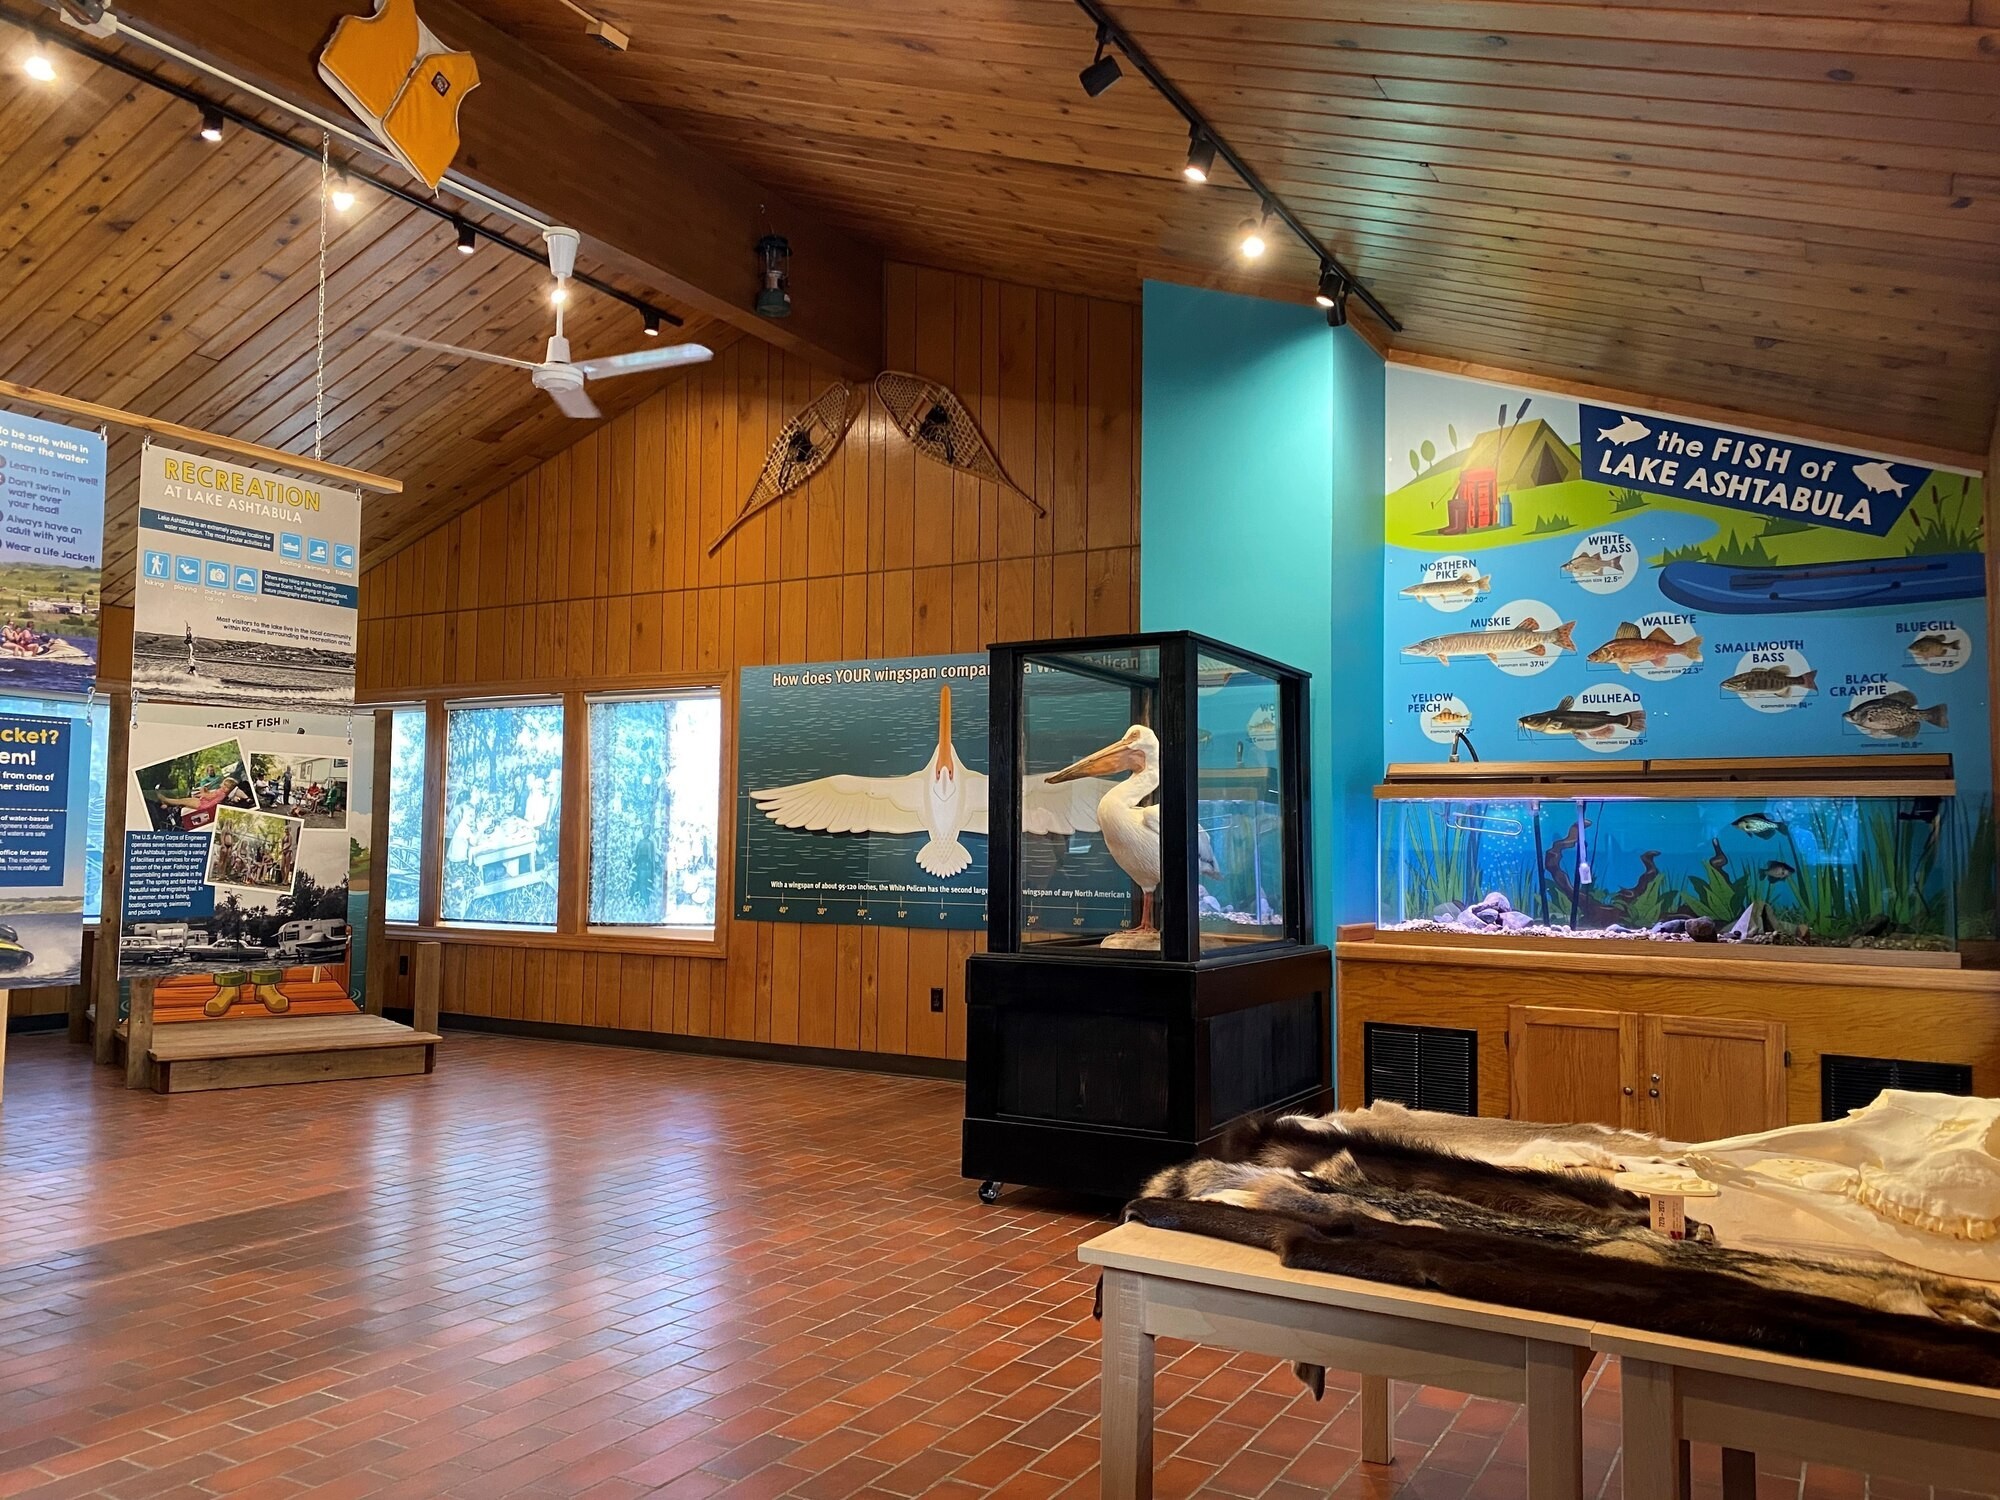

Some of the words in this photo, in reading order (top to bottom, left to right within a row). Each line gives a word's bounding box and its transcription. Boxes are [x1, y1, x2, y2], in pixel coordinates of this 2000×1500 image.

[12, 429, 25, 439] be
[28, 434, 49, 444] safe
[52, 440, 77, 450] while
[80, 445, 88, 454] in
[12, 443, 35, 452] near
[38, 446, 54, 457] the
[1658, 431, 1704, 457] the
[1712, 438, 1792, 474] FISH
[1800, 461, 1837, 482] of
[10, 461, 36, 472] Learn
[40, 467, 49, 476] to
[52, 470, 75, 481] swim
[9, 477, 33, 487] Don't
[36, 483, 60, 494] swim
[63, 487, 70, 496] in
[165, 458, 320, 511] RECREATION
[1599, 450, 1679, 486] LAKE
[1684, 468, 1872, 525] ASHTABULA
[9, 489, 37, 499] water
[40, 495, 62, 504] over
[8, 500, 29, 509] your
[33, 503, 59, 514] head!
[164, 484, 181, 498] AT
[187, 489, 222, 506] LAKE
[228, 499, 302, 523] ASHTABULA
[7, 514, 42, 528] Always
[45, 522, 68, 532] have
[171, 517, 194, 526] Ashtabula
[207, 525, 229, 533] extremely
[230, 529, 246, 537] popular
[6, 525, 30, 536] adult
[33, 530, 53, 540] with
[57, 534, 75, 544] you!
[1589, 534, 1624, 545] WHITE
[6, 541, 31, 552] Wear
[43, 547, 59, 557] Life
[61, 551, 94, 563] Jacket!
[1602, 544, 1631, 554] BASS
[1420, 560, 1476, 572] NORTHERN
[1436, 570, 1458, 579] PIKE
[145, 579, 164, 588] hiking
[174, 584, 197, 593] playing
[1470, 617, 1510, 628] MUSKIE
[1642, 614, 1696, 626] WALLEYE
[1896, 620, 1956, 633] BLUEGILL
[267, 630, 299, 640] surrounding
[310, 636, 337, 644] recreation
[323, 632, 352, 640] community
[1715, 640, 1804, 653] SMALLMOUTH
[1752, 653, 1784, 663] BASS
[773, 673, 799, 687] How
[802, 671, 832, 685] does
[835, 668, 871, 684] YOUR
[874, 667, 937, 684] wingspan
[1846, 673, 1888, 684] BLACK
[1830, 686, 1887, 696] CRAPPIE
[1412, 693, 1453, 703] YELLOW
[1583, 693, 1641, 704] BULLHEAD
[1408, 703, 1441, 712] PERCH
[256, 718, 281, 727] FISH
[3, 771, 24, 779] from
[45, 773, 54, 781] of
[16, 783, 49, 791] stations
[788, 881, 813, 889] wingspan
[822, 882, 837, 890] about
[858, 883, 878, 891] inches,
[1022, 888, 1052, 896] wingspan
[1062, 890, 1073, 898] any
[1094, 890, 1124, 898] American
